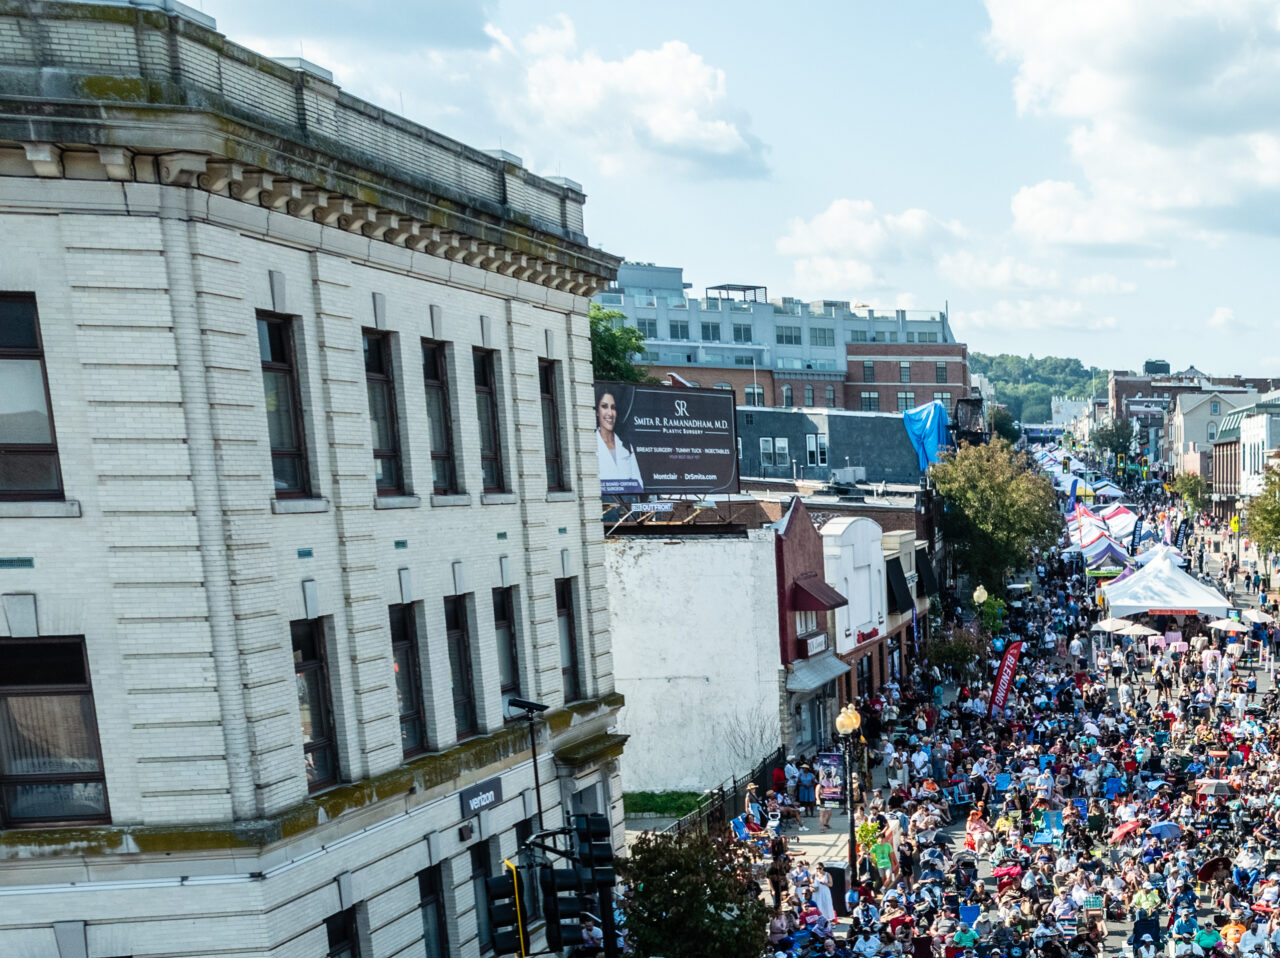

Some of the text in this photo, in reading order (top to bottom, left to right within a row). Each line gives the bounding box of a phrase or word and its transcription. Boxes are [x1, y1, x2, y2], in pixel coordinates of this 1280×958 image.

[674, 400, 690, 417] SR
[633, 416, 729, 429] SMITA R. RAMANADHAM, M.D.
[642, 503, 672, 512] OUTFRONT
[995, 654, 1016, 706] BLENDING
[469, 789, 495, 811] verizon
